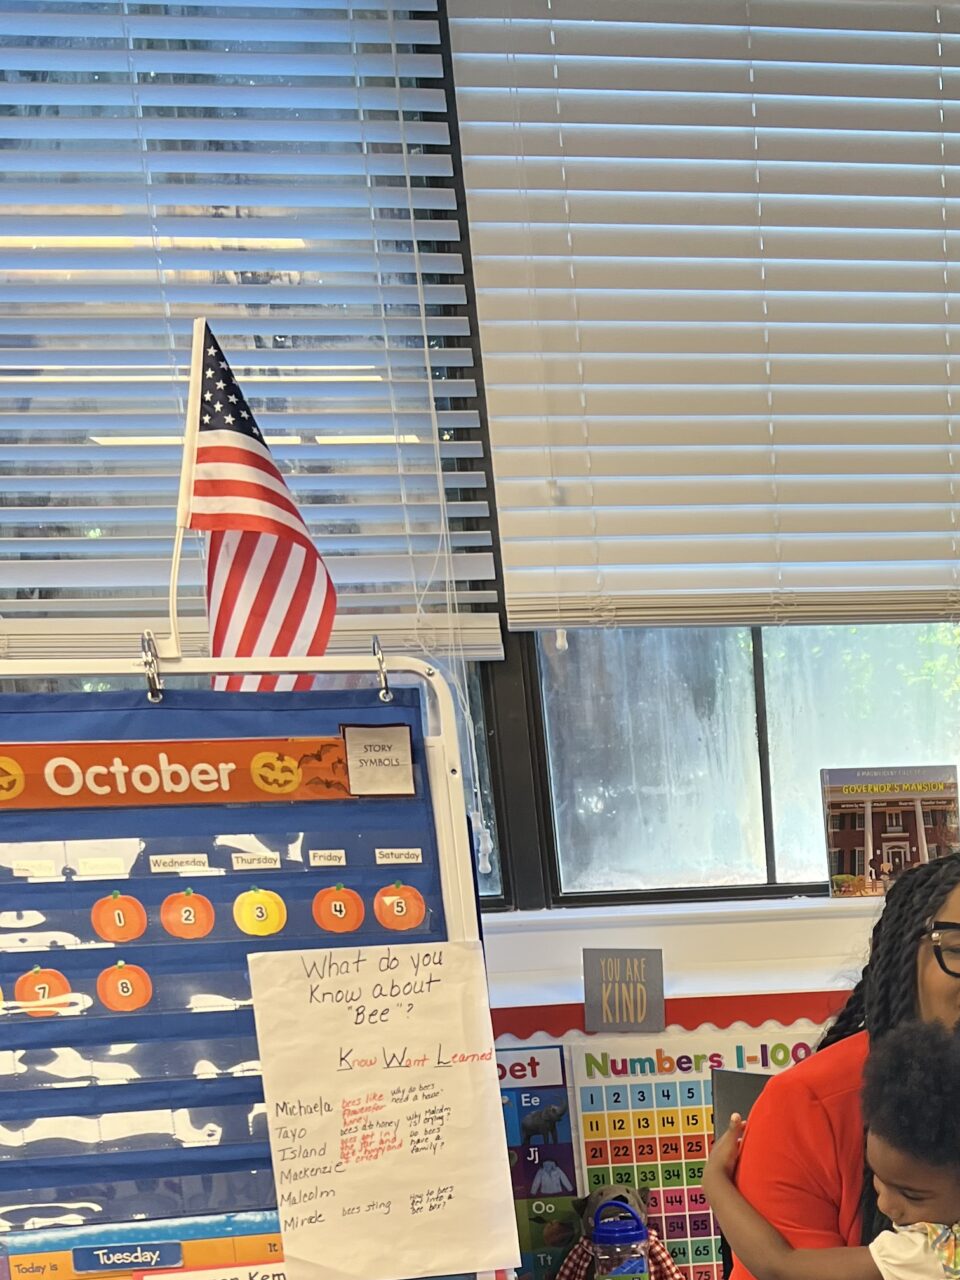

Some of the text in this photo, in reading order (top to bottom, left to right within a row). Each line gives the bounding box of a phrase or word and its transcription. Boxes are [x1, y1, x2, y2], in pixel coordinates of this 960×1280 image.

[363, 744, 393, 753] STORY
[358, 758, 400, 767] SYMBOLS
[44, 752, 236, 796] October
[902, 782, 945, 792] MANSION
[152, 851, 421, 869] Wednesday Thursday Friday Saturday
[255, 906, 265, 919] 3
[332, 903, 344, 916] 4
[395, 901, 405, 914] 5
[300, 948, 443, 979] What do you
[600, 957, 647, 982] YOU ARE
[37, 981, 132, 999] 7 8
[372, 973, 441, 998] about
[601, 982, 647, 1024] KIND
[337, 1043, 493, 1071] Know Want Learned
[584, 1041, 812, 1079] Numbers 1-100
[521, 1093, 540, 1107] Ee
[589, 1087, 695, 1104] 1 2 3 4 5
[276, 1096, 333, 1117] Michaela
[589, 1114, 699, 1131] 11 12 13 14 15
[275, 1127, 307, 1142] Tayo
[277, 1141, 327, 1161] Island
[526, 1148, 539, 1164] Jj
[590, 1141, 703, 1159] 21 22 23 24 25
[280, 1161, 347, 1185] Mackenzie
[592, 1167, 704, 1185] 31 32 33 34 35
[280, 1186, 336, 1207] Malcolm
[666, 1195, 683, 1206] 44
[690, 1193, 706, 1204] 45
[342, 1200, 392, 1216] bees sting
[532, 1201, 555, 1214] Oo
[668, 1221, 685, 1233] 54
[692, 1220, 708, 1231] 55
[267, 1243, 279, 1253] It
[671, 1245, 710, 1258] 64 65
[93, 1248, 161, 1266] Tuesday.
[537, 1253, 552, 1266] Tt
[14, 1262, 58, 1275] Today is
[696, 1271, 711, 1280] 75
